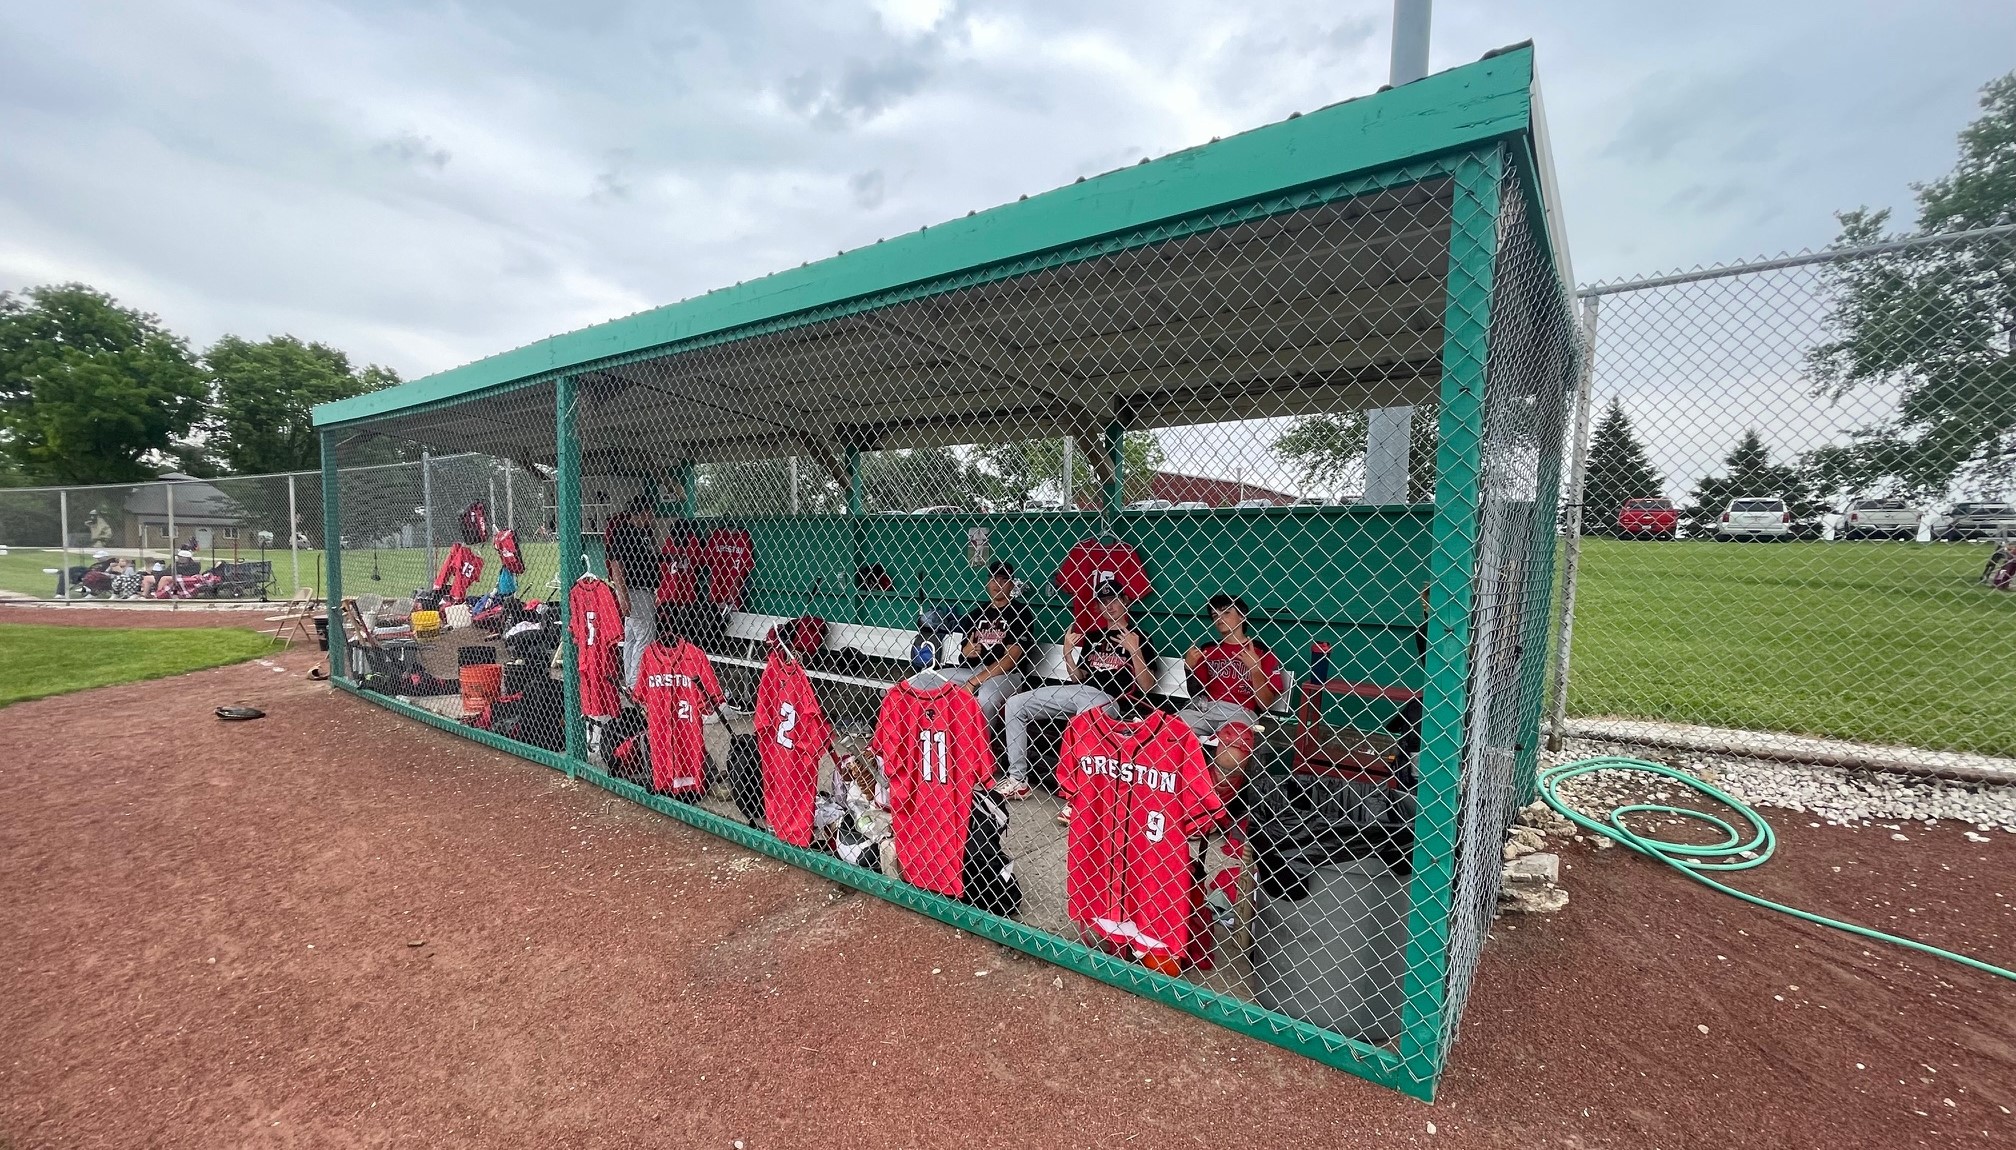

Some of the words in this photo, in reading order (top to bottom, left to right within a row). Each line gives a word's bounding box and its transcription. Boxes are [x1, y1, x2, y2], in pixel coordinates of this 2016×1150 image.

[462, 562, 475, 578] 13
[776, 701, 796, 749] 2
[919, 729, 947, 784] 11
[1080, 755, 1177, 793] CRESTON
[1146, 810, 1165, 843] 9
